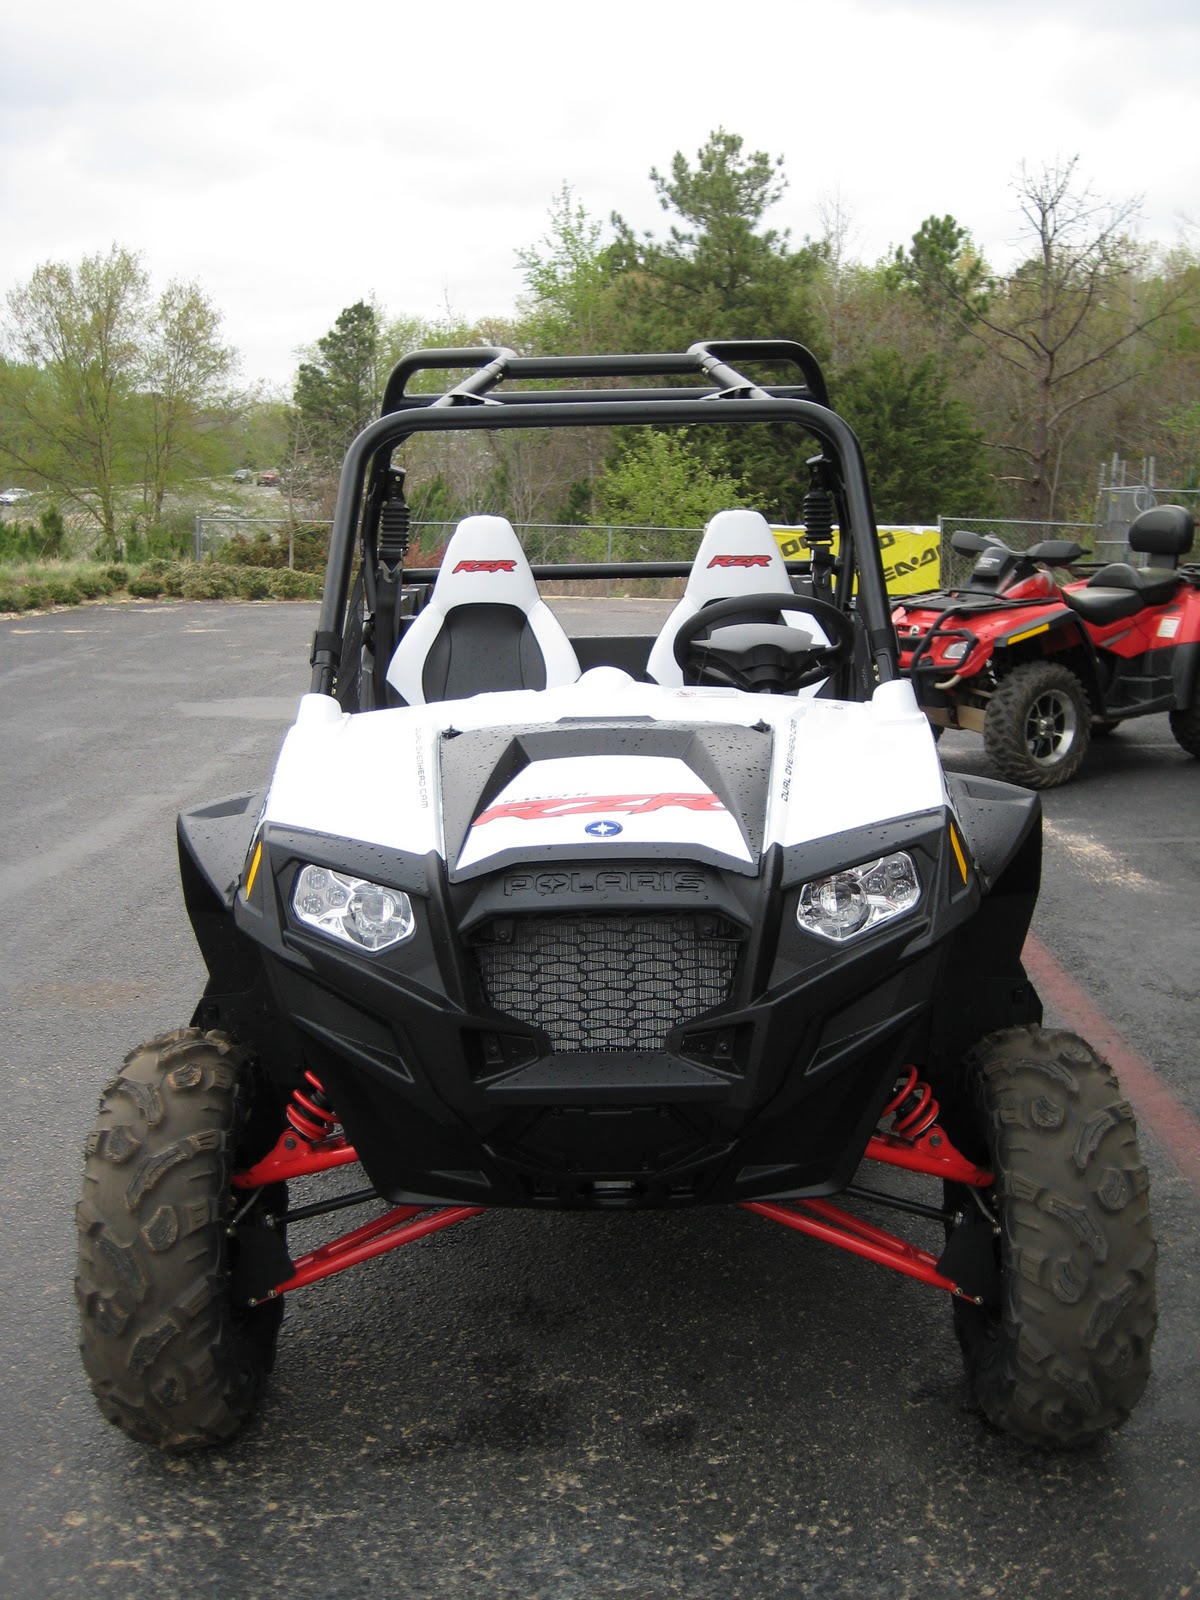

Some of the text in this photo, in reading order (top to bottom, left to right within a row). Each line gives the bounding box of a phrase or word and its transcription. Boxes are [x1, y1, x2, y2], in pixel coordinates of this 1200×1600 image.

[451, 559, 518, 574] RZR
[706, 554, 773, 569] RZR
[784, 734, 797, 776] OVERHEAD
[419, 788, 429, 809] CAM
[780, 777, 791, 803] DUAL
[471, 793, 728, 828] RZR
[503, 871, 707, 896] POLARIS
